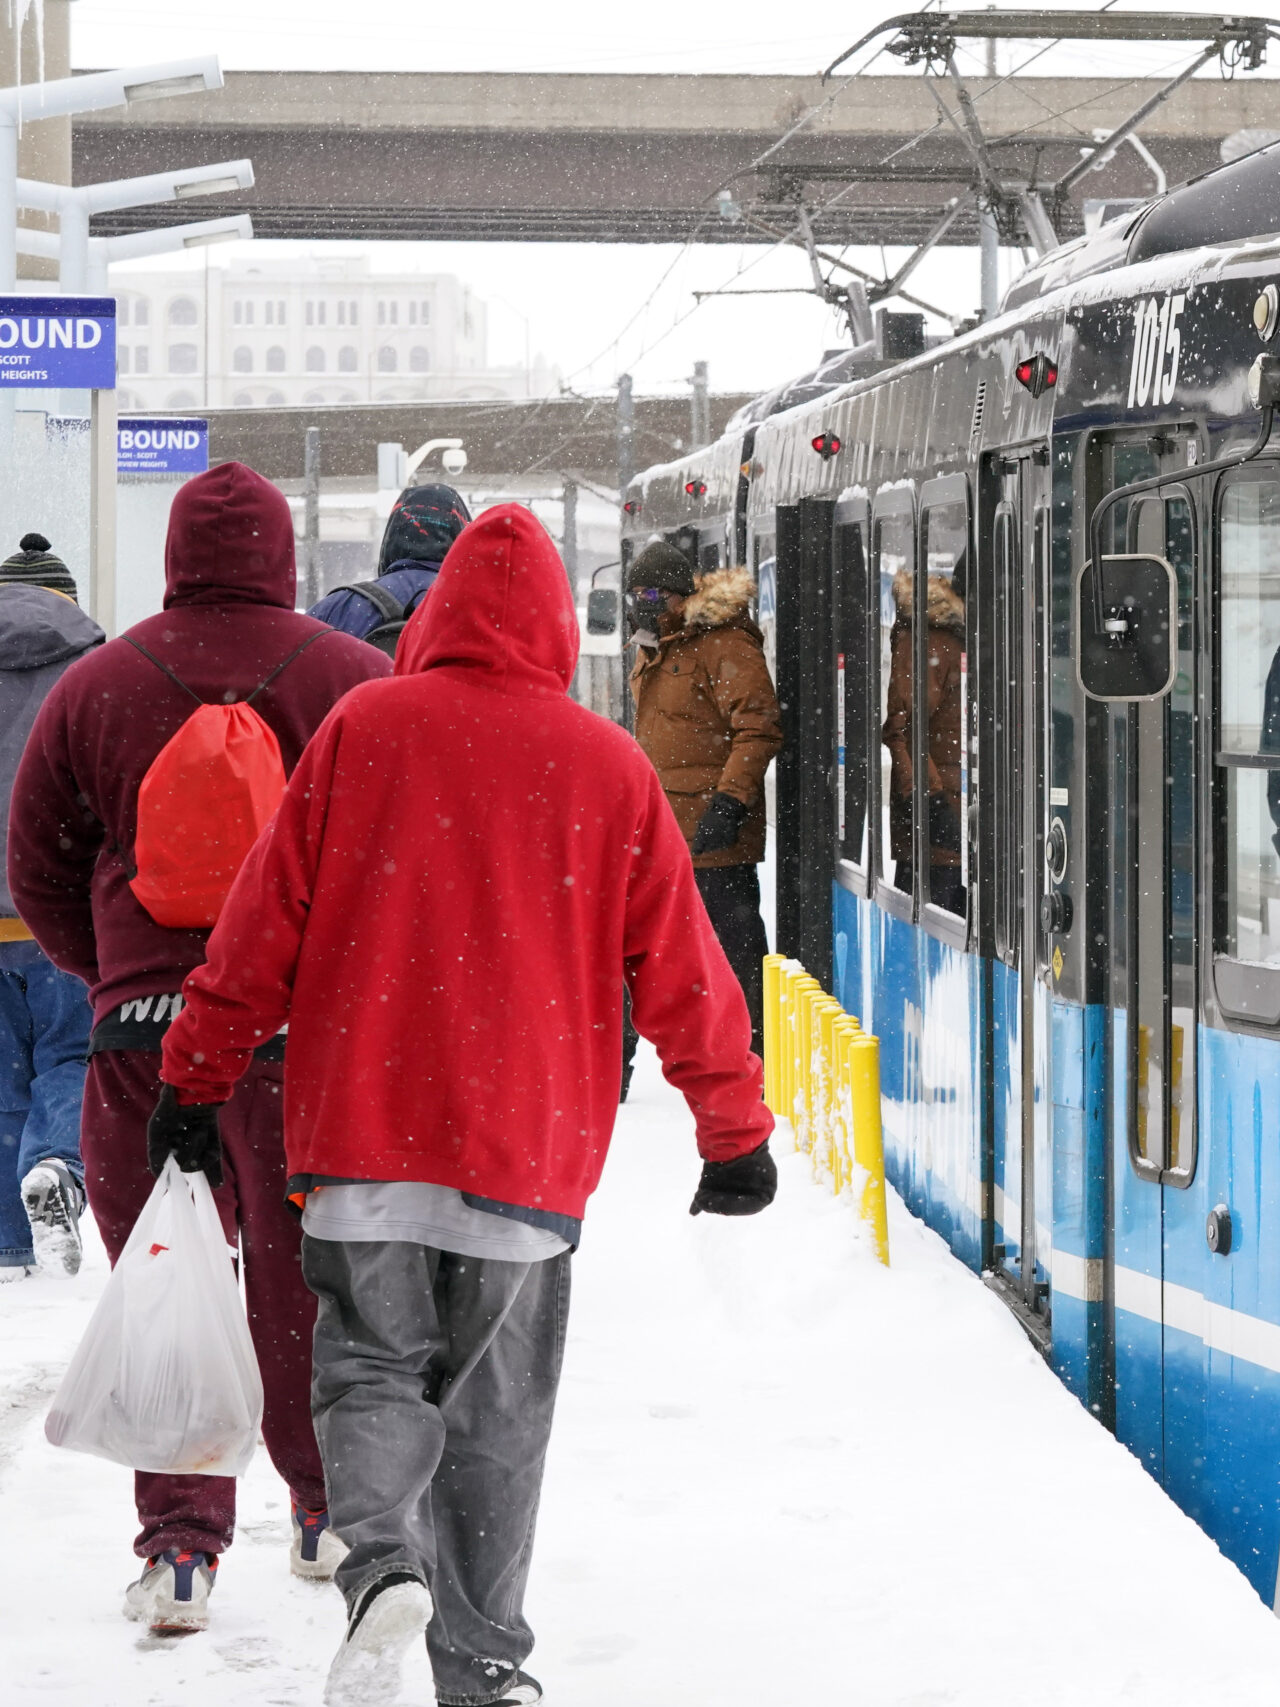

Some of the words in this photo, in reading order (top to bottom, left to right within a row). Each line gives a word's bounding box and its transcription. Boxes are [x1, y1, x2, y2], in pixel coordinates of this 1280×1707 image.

[1127, 294, 1186, 409] 1015
[1, 370, 48, 380] HEIGHTS
[118, 430, 200, 450] BOUND
[139, 461, 168, 469] HEIGHTS
